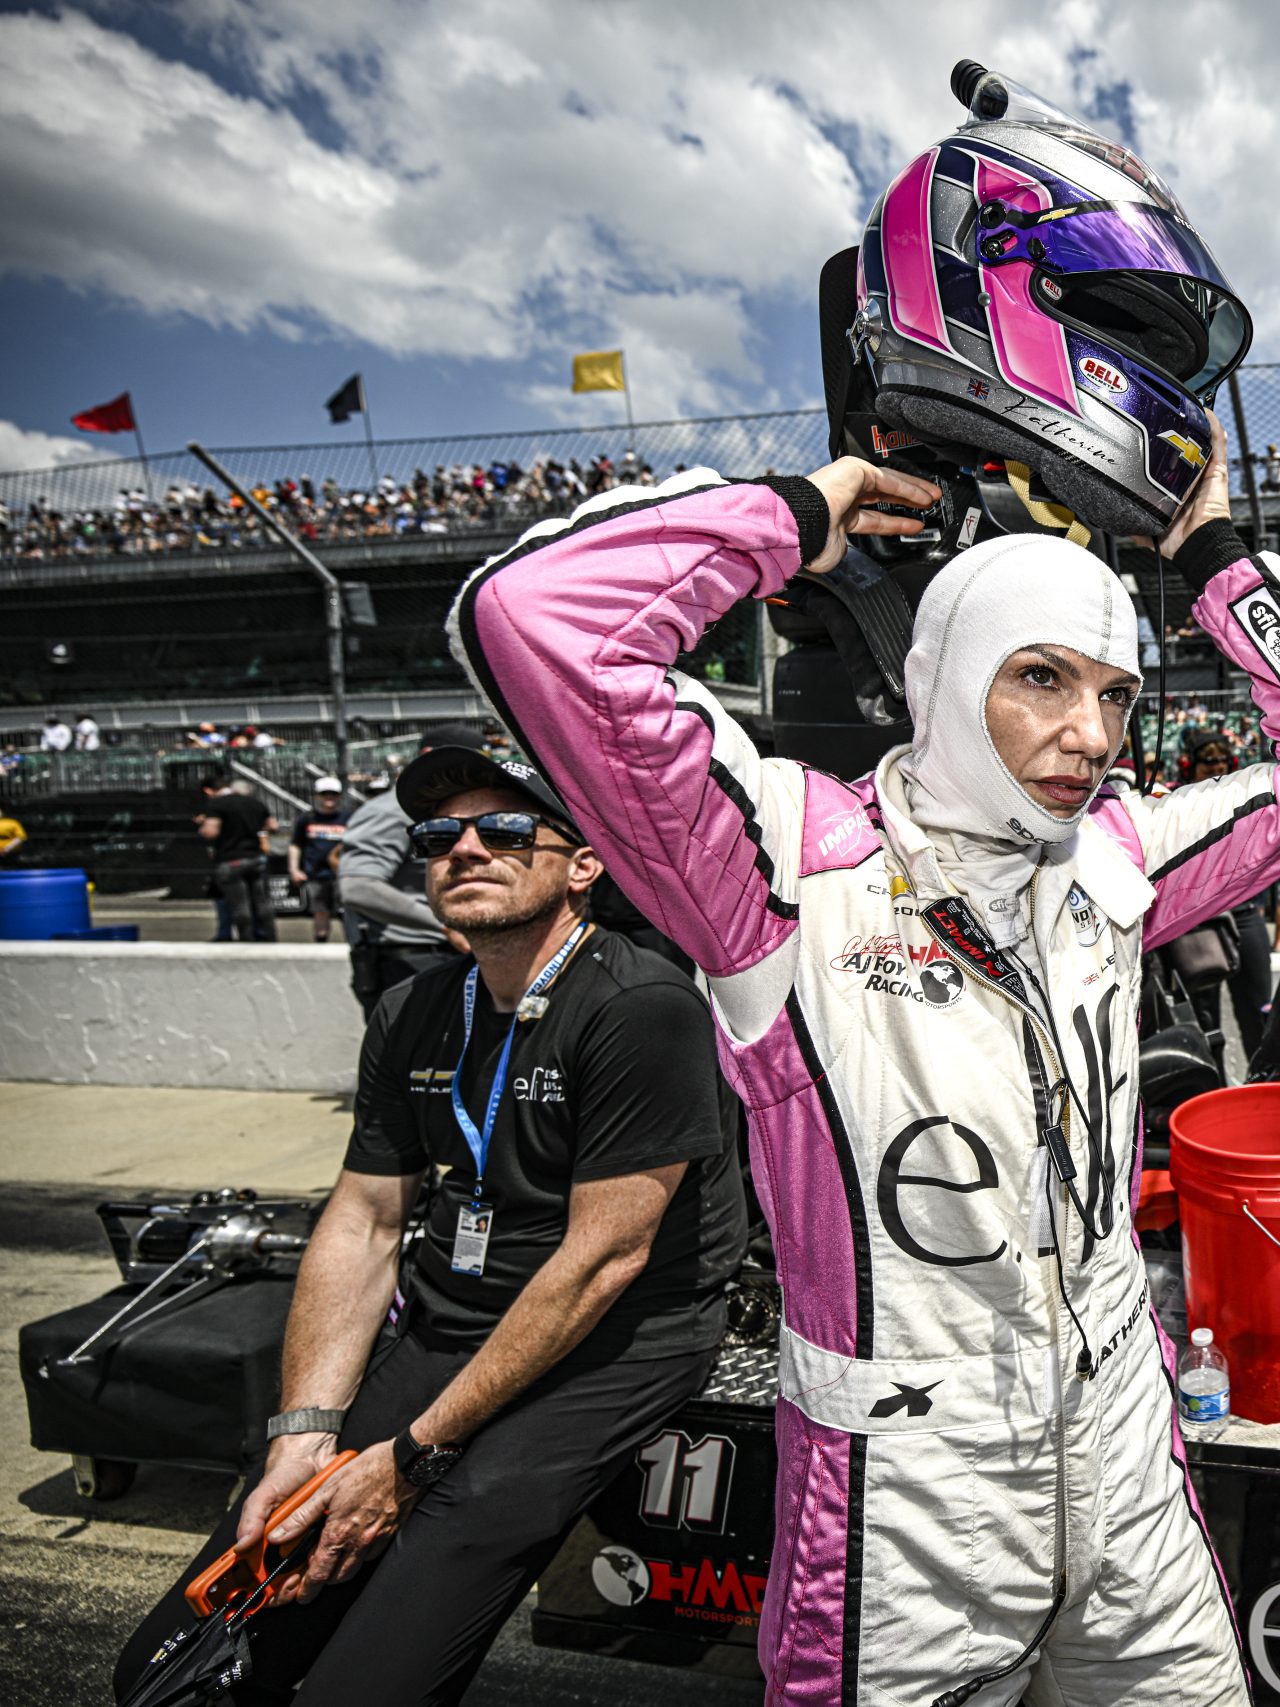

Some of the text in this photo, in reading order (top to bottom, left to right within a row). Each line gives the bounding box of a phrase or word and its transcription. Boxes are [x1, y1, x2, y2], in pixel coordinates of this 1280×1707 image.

[1044, 279, 1061, 297] BELL
[1083, 359, 1121, 389] BELL
[871, 425, 920, 458] han
[1252, 606, 1277, 630] sfi
[932, 909, 986, 960] IMPACT
[526, 959, 561, 998] INDYCA
[873, 955, 907, 976] FOY
[864, 974, 924, 1003] RACING
[923, 996, 963, 1010] OTORSPORTS
[637, 1431, 731, 1528] 11
[674, 1607, 762, 1627] MOTORSPORT
